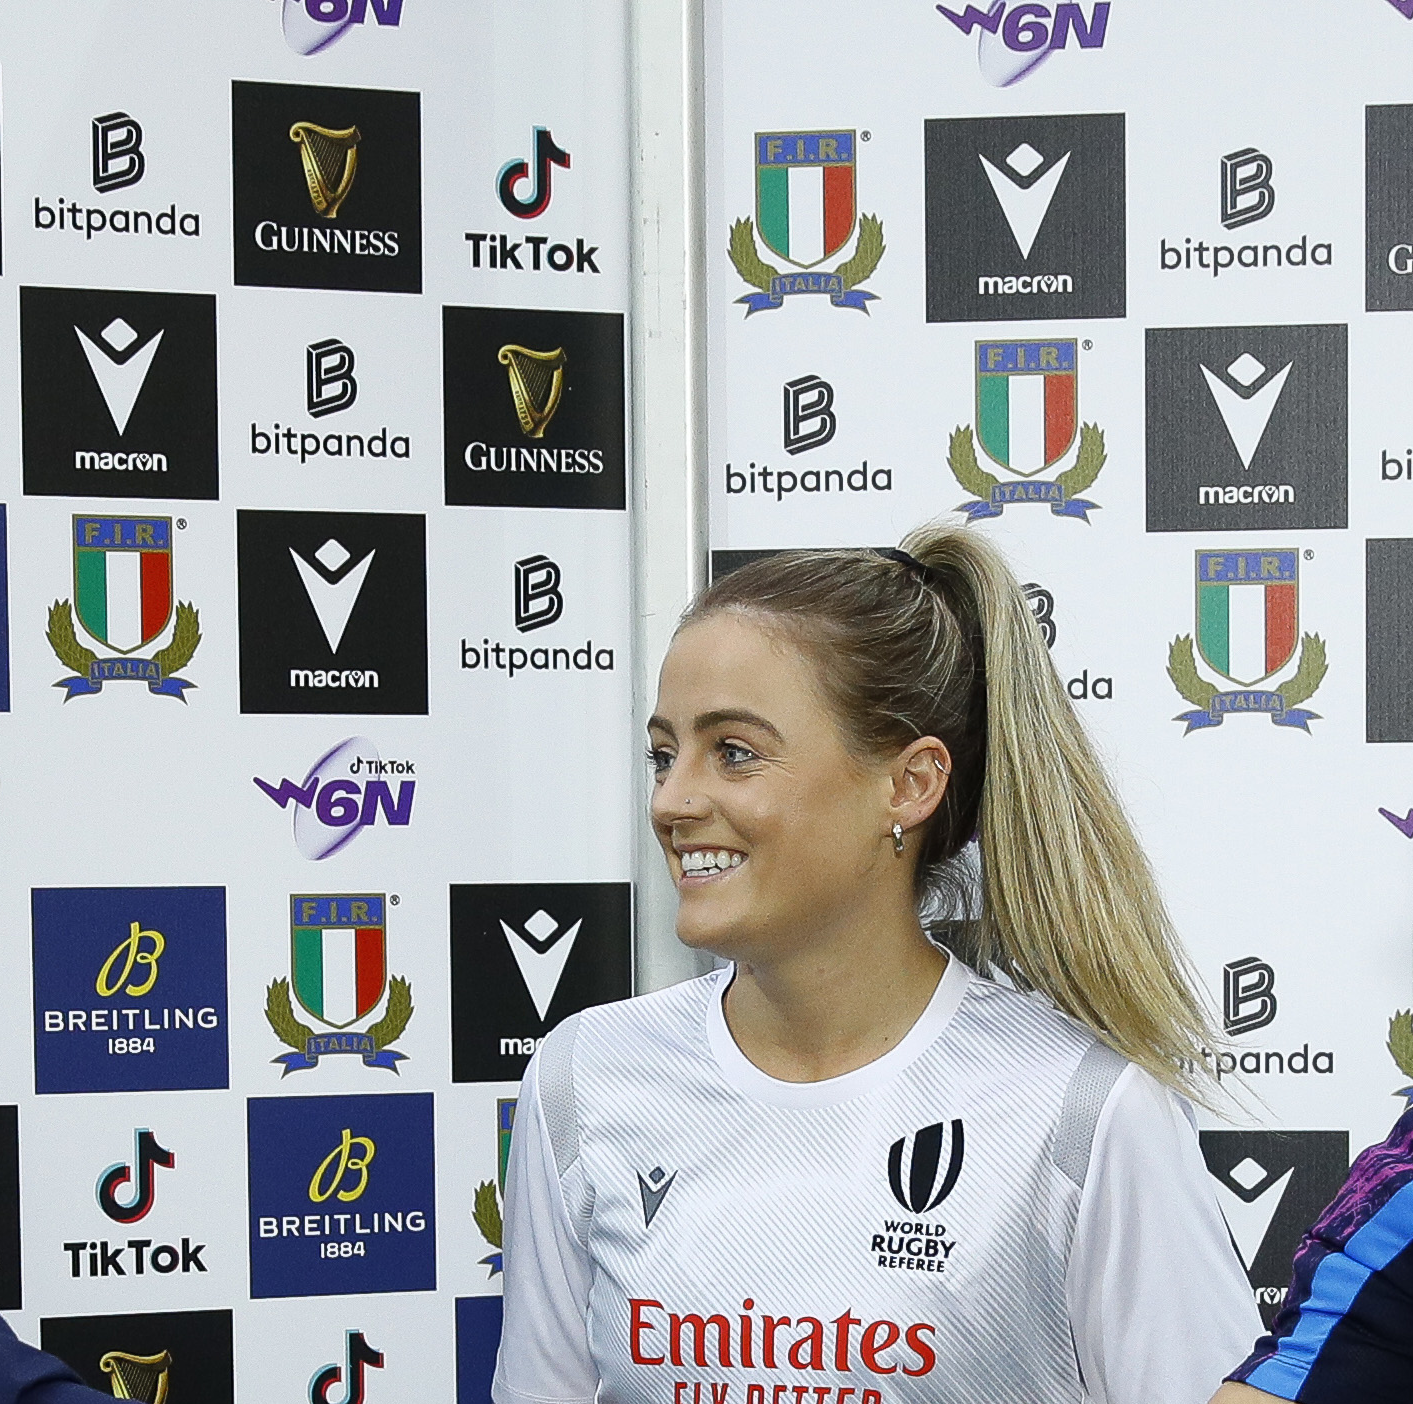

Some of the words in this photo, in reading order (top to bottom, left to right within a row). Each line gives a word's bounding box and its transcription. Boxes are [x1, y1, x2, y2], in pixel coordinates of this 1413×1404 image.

[767, 139, 848, 161] F.I.R.
[35, 198, 199, 239] bitpanda
[255, 221, 398, 256] GUINNESS
[465, 233, 599, 273] TikTok
[1161, 235, 1331, 277] bitpanda
[772, 275, 841, 294] ITALIA
[979, 275, 1072, 294] macron
[986, 347, 1069, 369] F.I.R.
[252, 423, 409, 463] bitpanda
[76, 452, 167, 471] macron
[465, 442, 603, 473] GUINNESS
[726, 461, 891, 501] bitpanda
[993, 484, 1062, 502] ITALIA
[1200, 486, 1294, 504] macron
[85, 523, 164, 545] F.I.R.
[1208, 557, 1291, 578] F.I.R.
[462, 639, 613, 677] bitpanda
[91, 662, 160, 680] ITALIA
[291, 670, 378, 687] macron
[1213, 693, 1283, 713] ITALIA
[366, 760, 415, 774] TikTok
[302, 901, 378, 922] F.I.R.
[45, 1008, 217, 1031] BREITLING
[109, 1038, 154, 1053] 1884
[310, 1037, 372, 1052] ITALIA
[260, 1212, 425, 1237] BREITLING
[885, 1220, 946, 1237] WORLD
[64, 1238, 207, 1277] TikTok
[321, 1242, 365, 1258] 1884
[871, 1236, 956, 1259] RUGBY
[878, 1254, 945, 1274] REFEREE
[629, 1298, 936, 1376] Emirates
